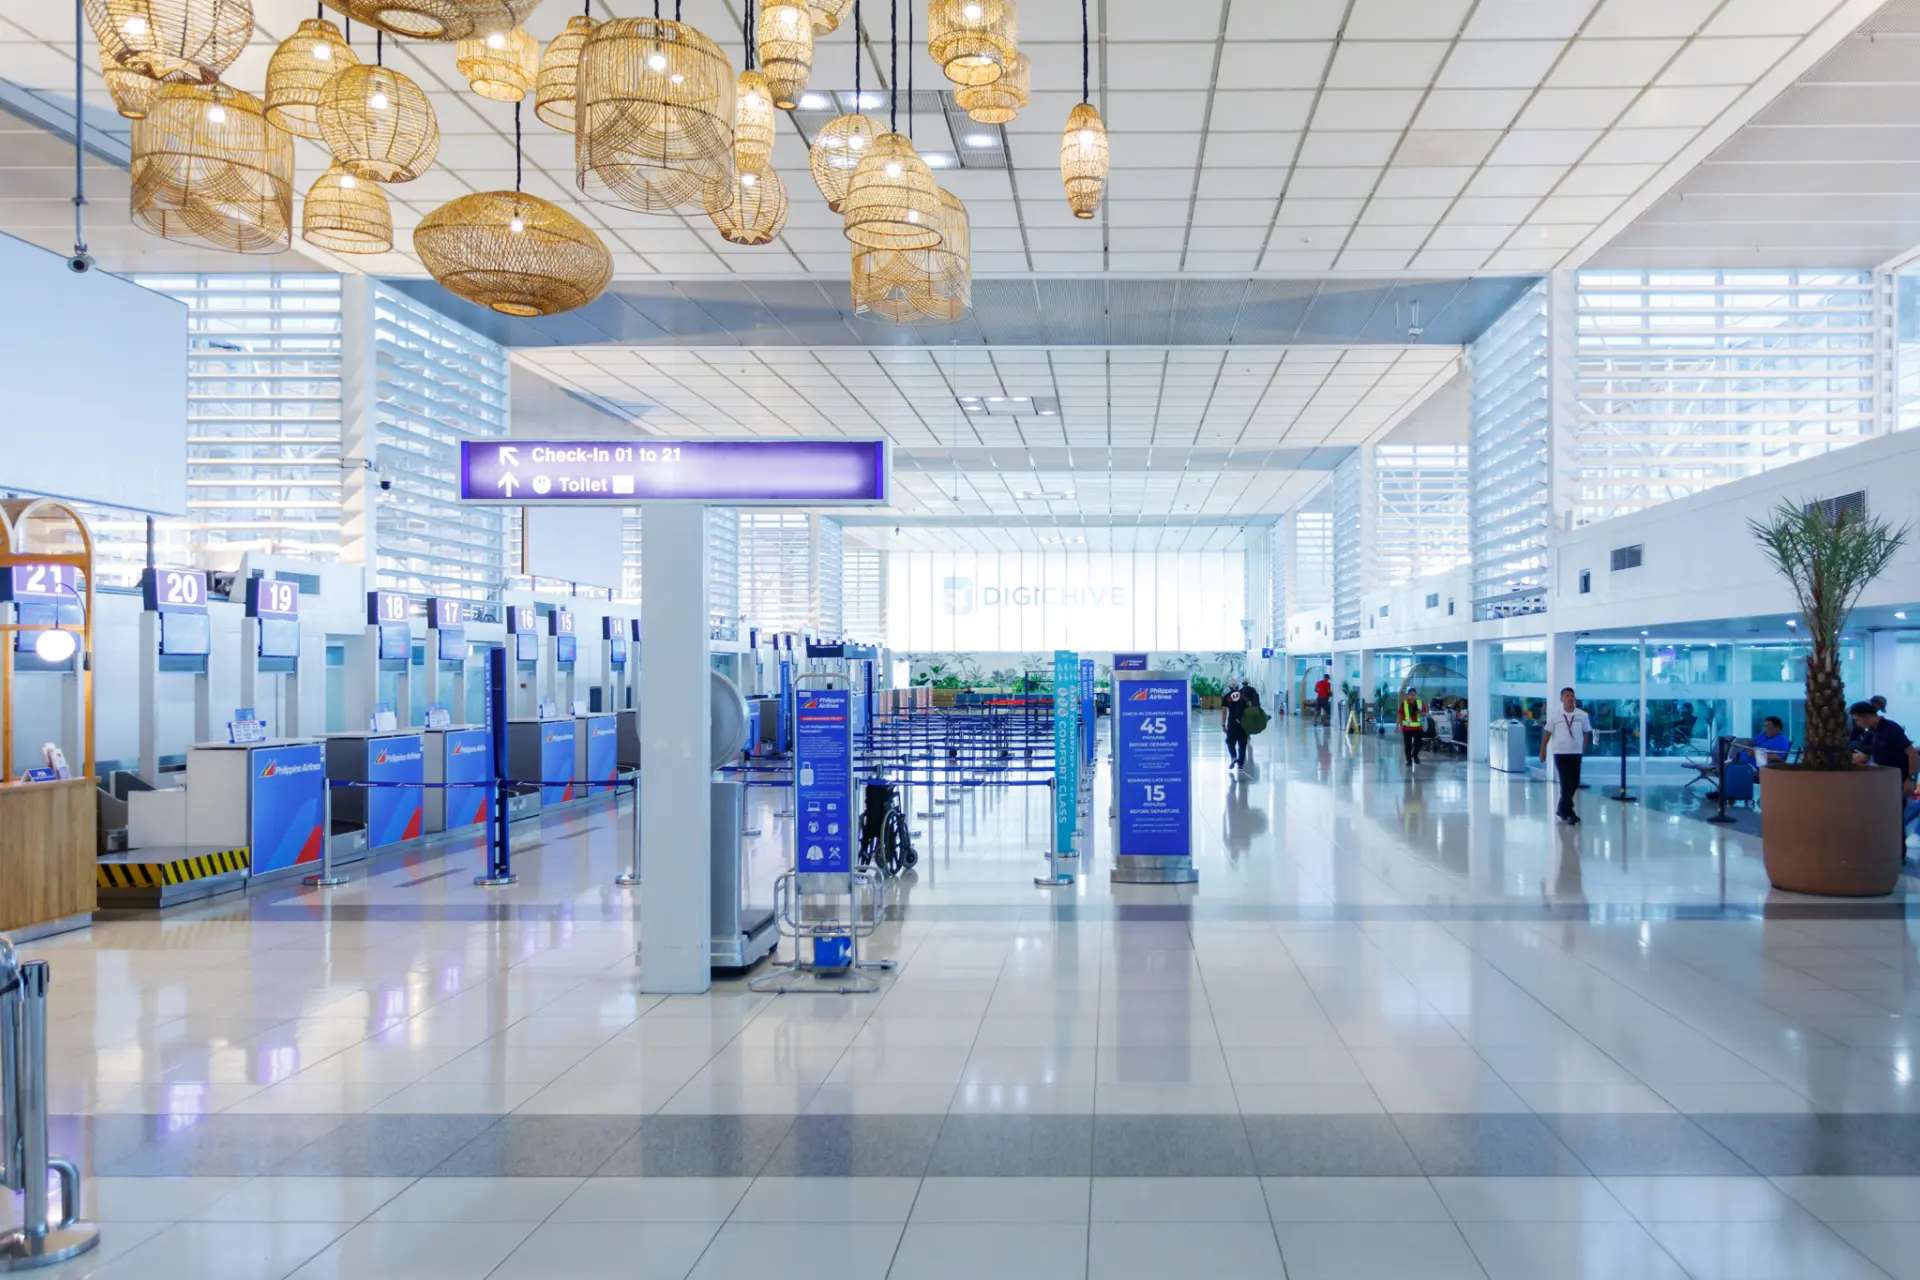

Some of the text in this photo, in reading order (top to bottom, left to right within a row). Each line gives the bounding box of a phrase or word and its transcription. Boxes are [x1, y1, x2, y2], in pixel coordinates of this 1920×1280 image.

[532, 447, 681, 463] Check-In 01 to 21
[558, 477, 608, 493] Toilet
[26, 565, 62, 593] 21
[166, 572, 198, 603] 20
[270, 583, 291, 611] 19
[386, 597, 403, 620] 18
[444, 601, 459, 623] 17
[521, 607, 534, 628] 16
[561, 613, 572, 631] 15
[613, 617, 623, 634] 14
[1149, 687, 1179, 695] Philippine
[1140, 717, 1168, 734] 45
[275, 762, 322, 776] Philippine Airlines
[1058, 721, 1067, 824] COMFORT CLASS
[1143, 785, 1166, 801] 15
